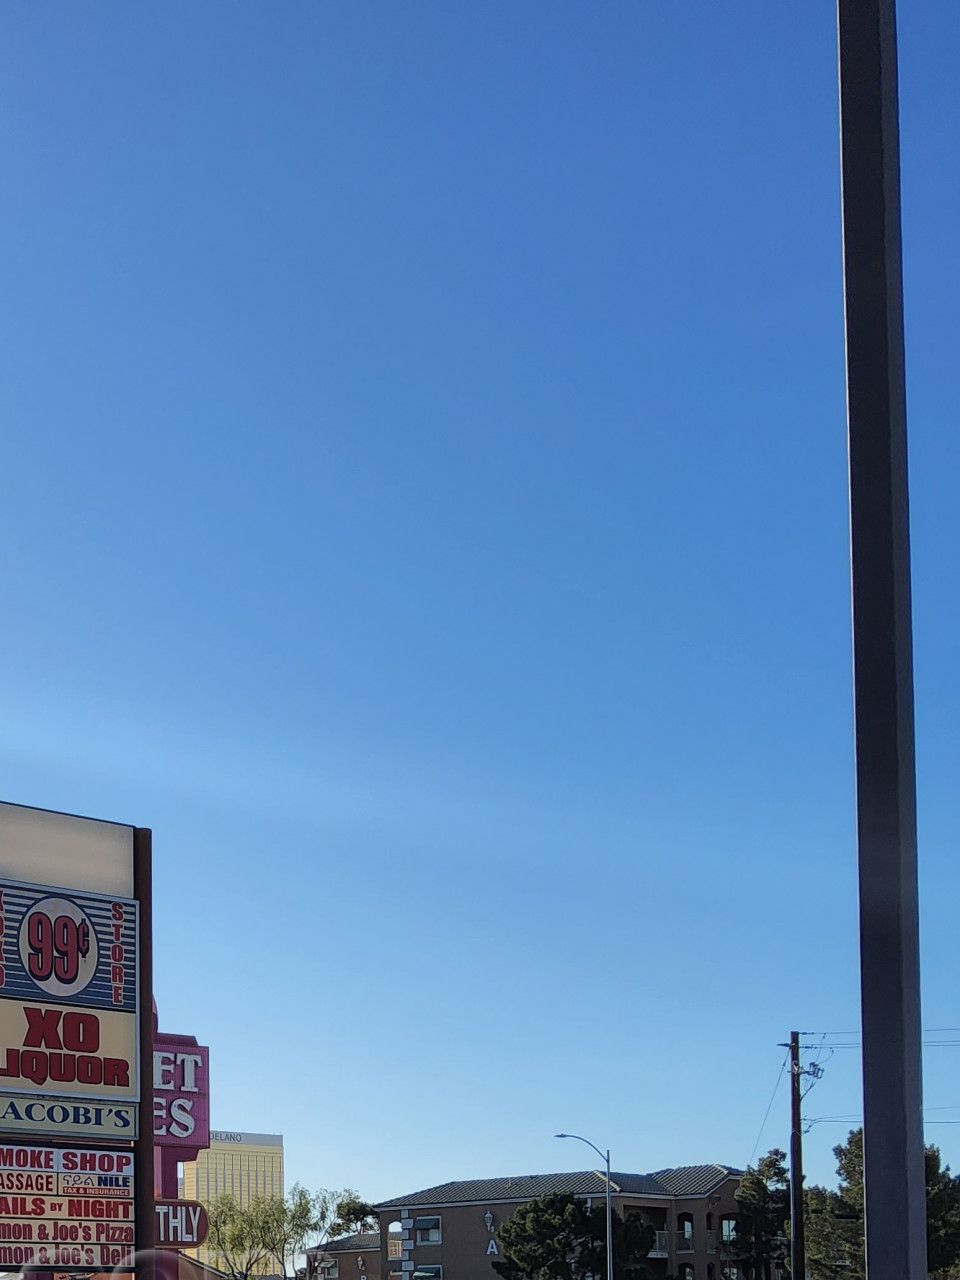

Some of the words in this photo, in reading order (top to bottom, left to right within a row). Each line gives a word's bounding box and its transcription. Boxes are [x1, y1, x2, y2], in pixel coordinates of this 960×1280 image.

[111, 901, 125, 1005] STORE
[22, 1006, 100, 1053] XO
[62, 1151, 132, 1173] SHOP
[86, 1188, 130, 1196] INSURANCE
[97, 1176, 130, 1188] NILE
[50, 1202, 64, 1212] BY
[67, 1198, 133, 1219] NIGHT
[37, 1223, 50, 1241] &
[52, 1221, 92, 1242] Joe's
[95, 1222, 134, 1243] Pizza
[154, 1205, 202, 1243] THLY
[38, 1246, 51, 1265] &
[53, 1243, 95, 1266] Joe's
[99, 1245, 133, 1266] Deli
[486, 1239, 499, 1255] A
